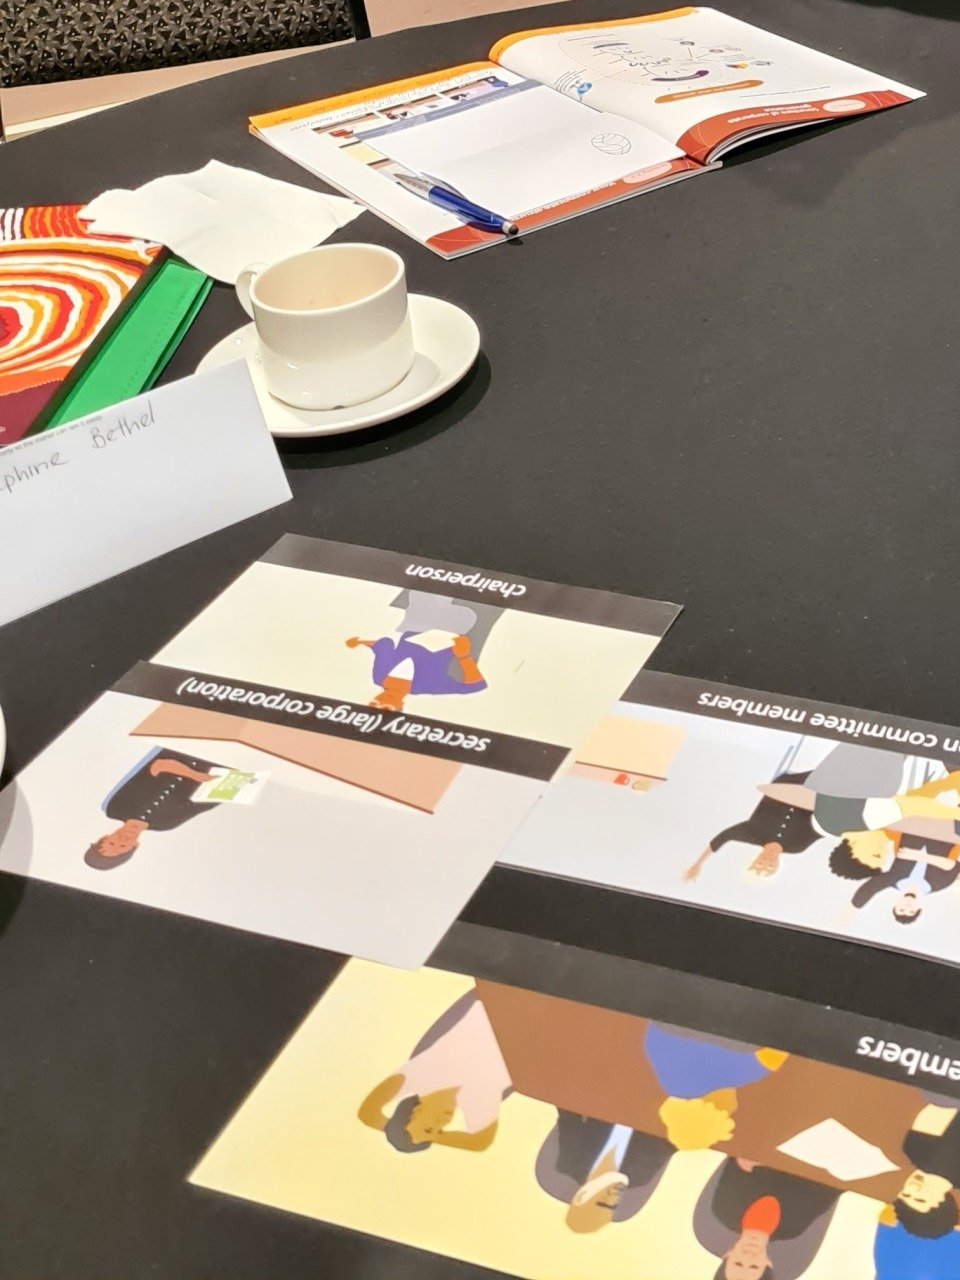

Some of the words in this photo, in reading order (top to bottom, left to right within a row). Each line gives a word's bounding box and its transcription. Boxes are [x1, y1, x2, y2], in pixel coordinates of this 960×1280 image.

[0, 451, 70, 494] phine
[90, 399, 156, 449] Bethel
[404, 563, 527, 599] chairperson
[176, 676, 314, 716] corporation)
[697, 691, 806, 724] members
[315, 704, 384, 734] (large
[383, 716, 491, 752] secretary
[810, 712, 938, 747] committee
